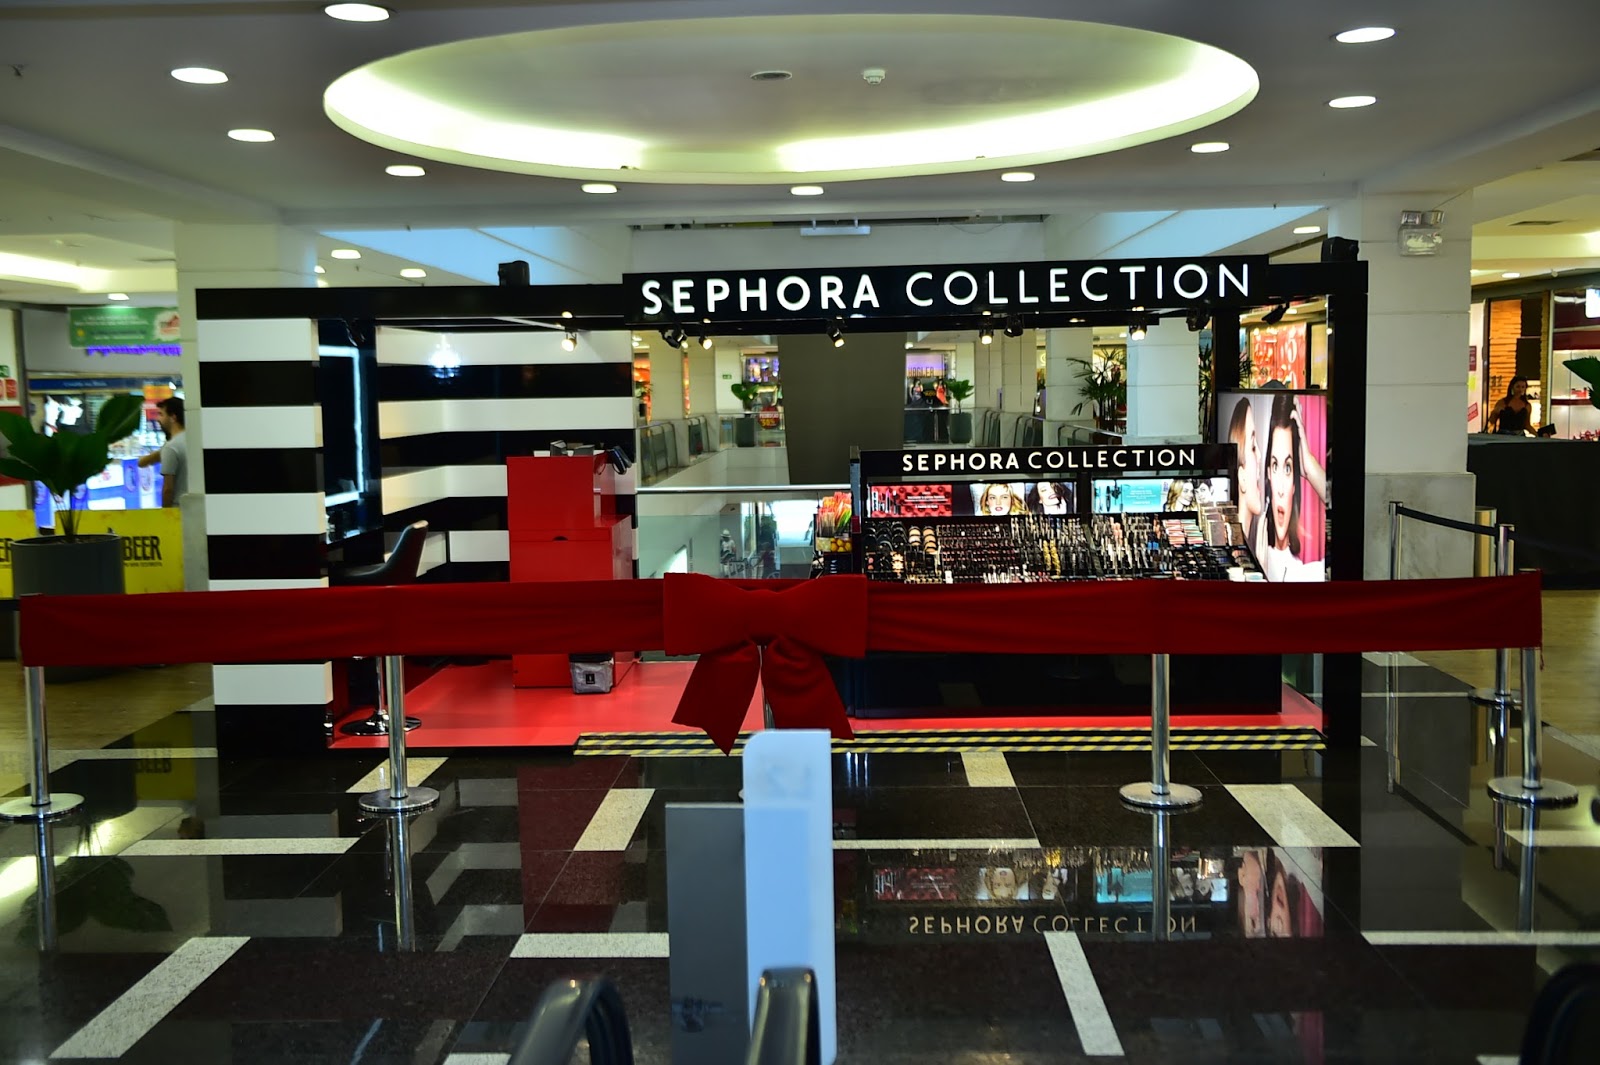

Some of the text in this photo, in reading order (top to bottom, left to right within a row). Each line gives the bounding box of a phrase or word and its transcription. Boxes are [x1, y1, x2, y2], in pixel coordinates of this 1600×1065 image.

[641, 263, 1249, 315] SEPHORA COLLECTION
[902, 449, 1195, 471] SEPHORA COLLECTION
[121, 536, 162, 560] BEER
